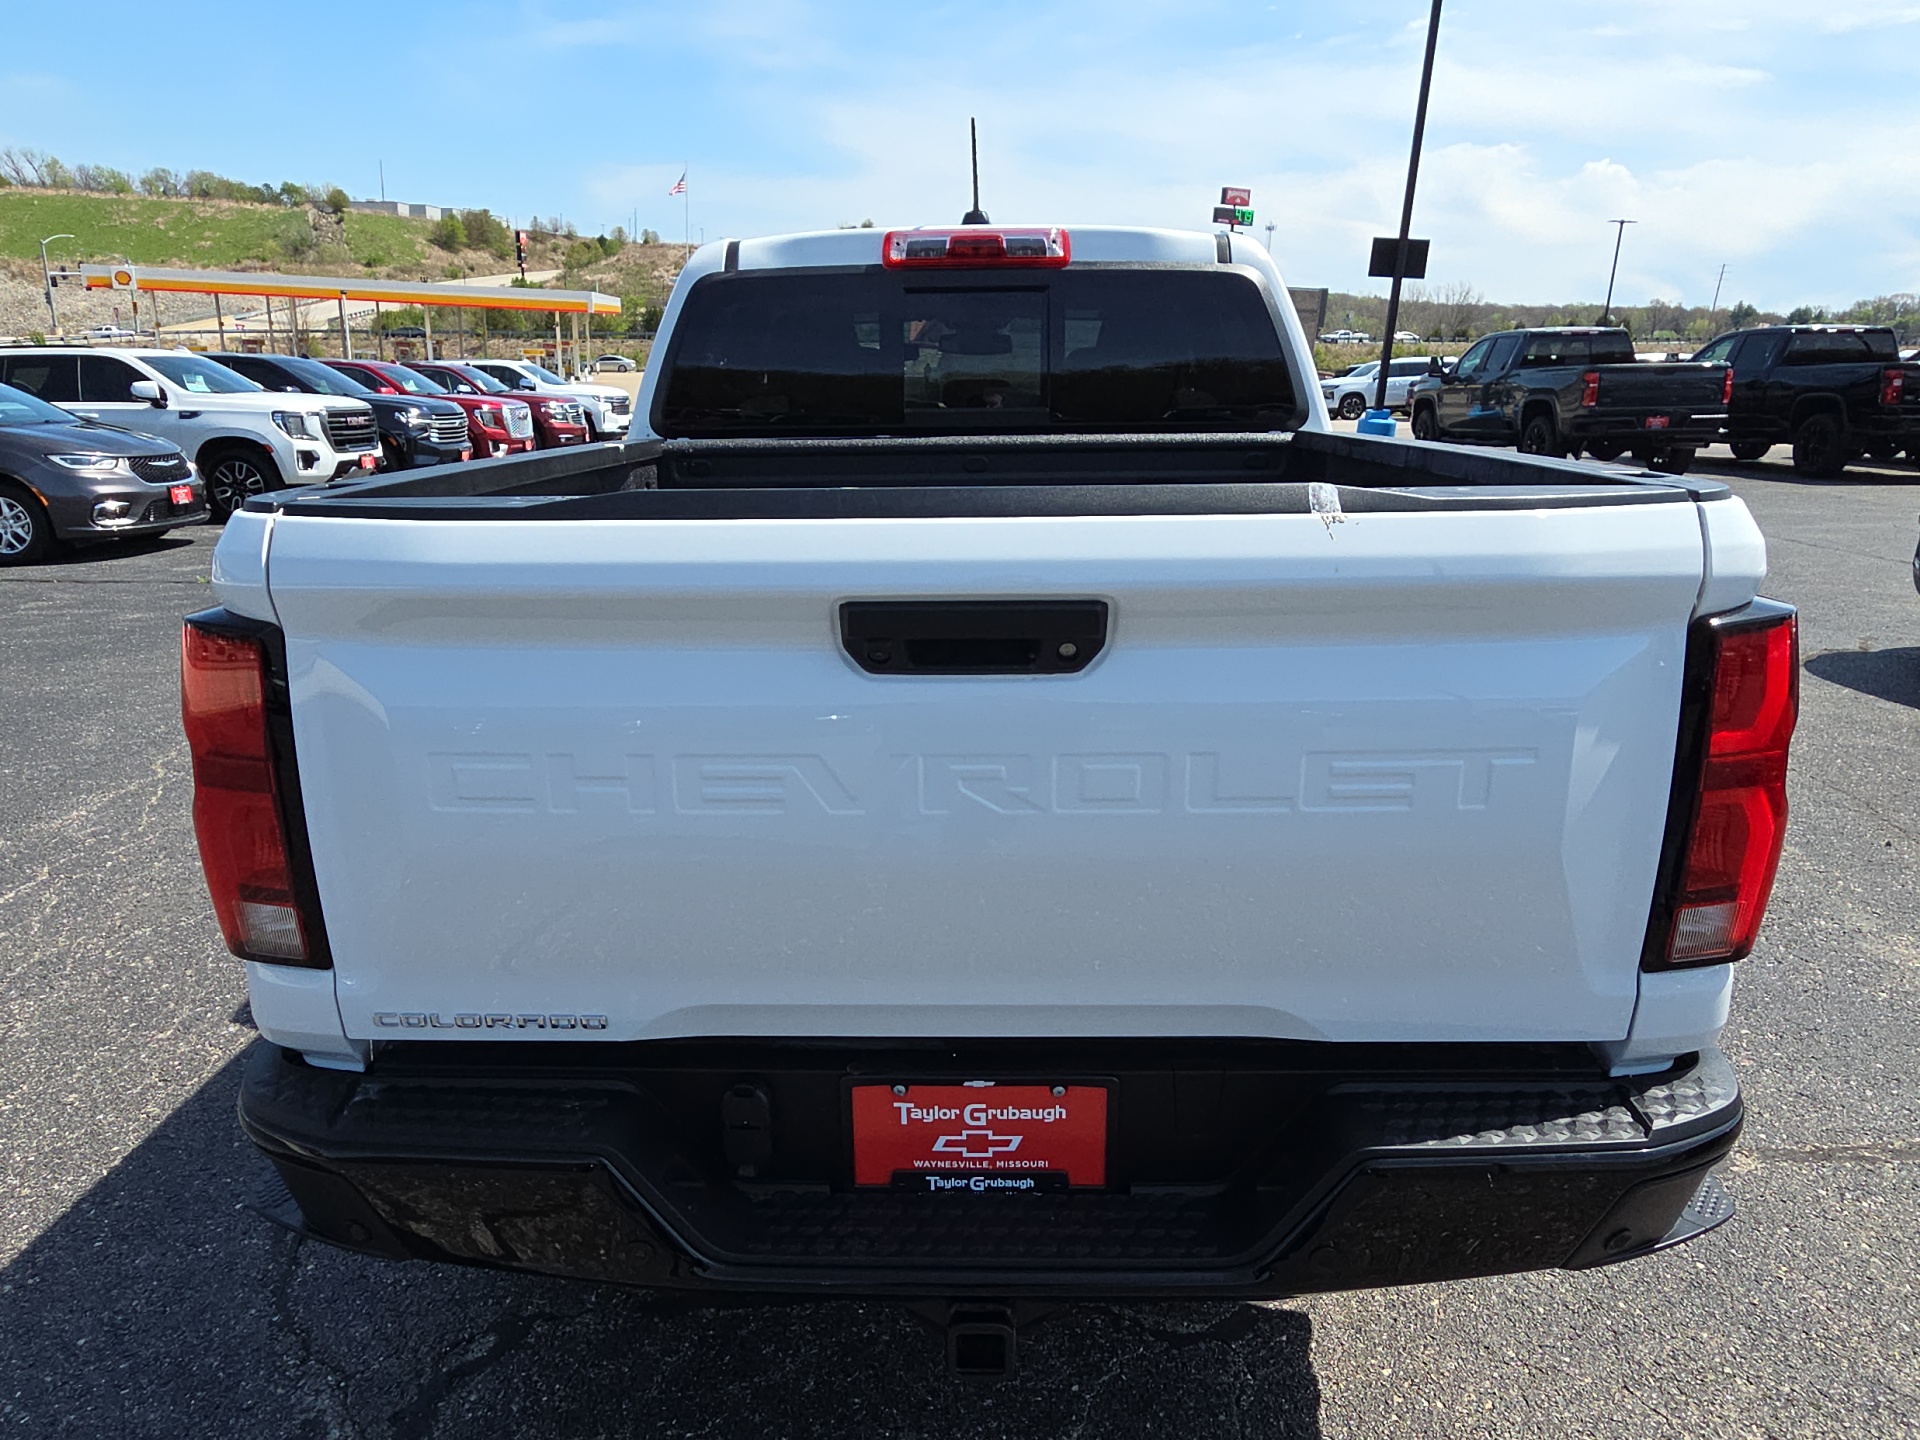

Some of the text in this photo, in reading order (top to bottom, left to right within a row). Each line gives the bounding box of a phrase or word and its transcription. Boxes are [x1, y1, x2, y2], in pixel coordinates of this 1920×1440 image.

[427, 747, 1539, 816] CHEVROLET
[373, 1012, 608, 1029] COLORADO
[893, 1102, 1067, 1126] Taylor Grubaugh
[913, 1160, 1049, 1169] WAYNESVILLE, MISSOURI
[925, 1176, 1034, 1191] Taylor Grubaugh
